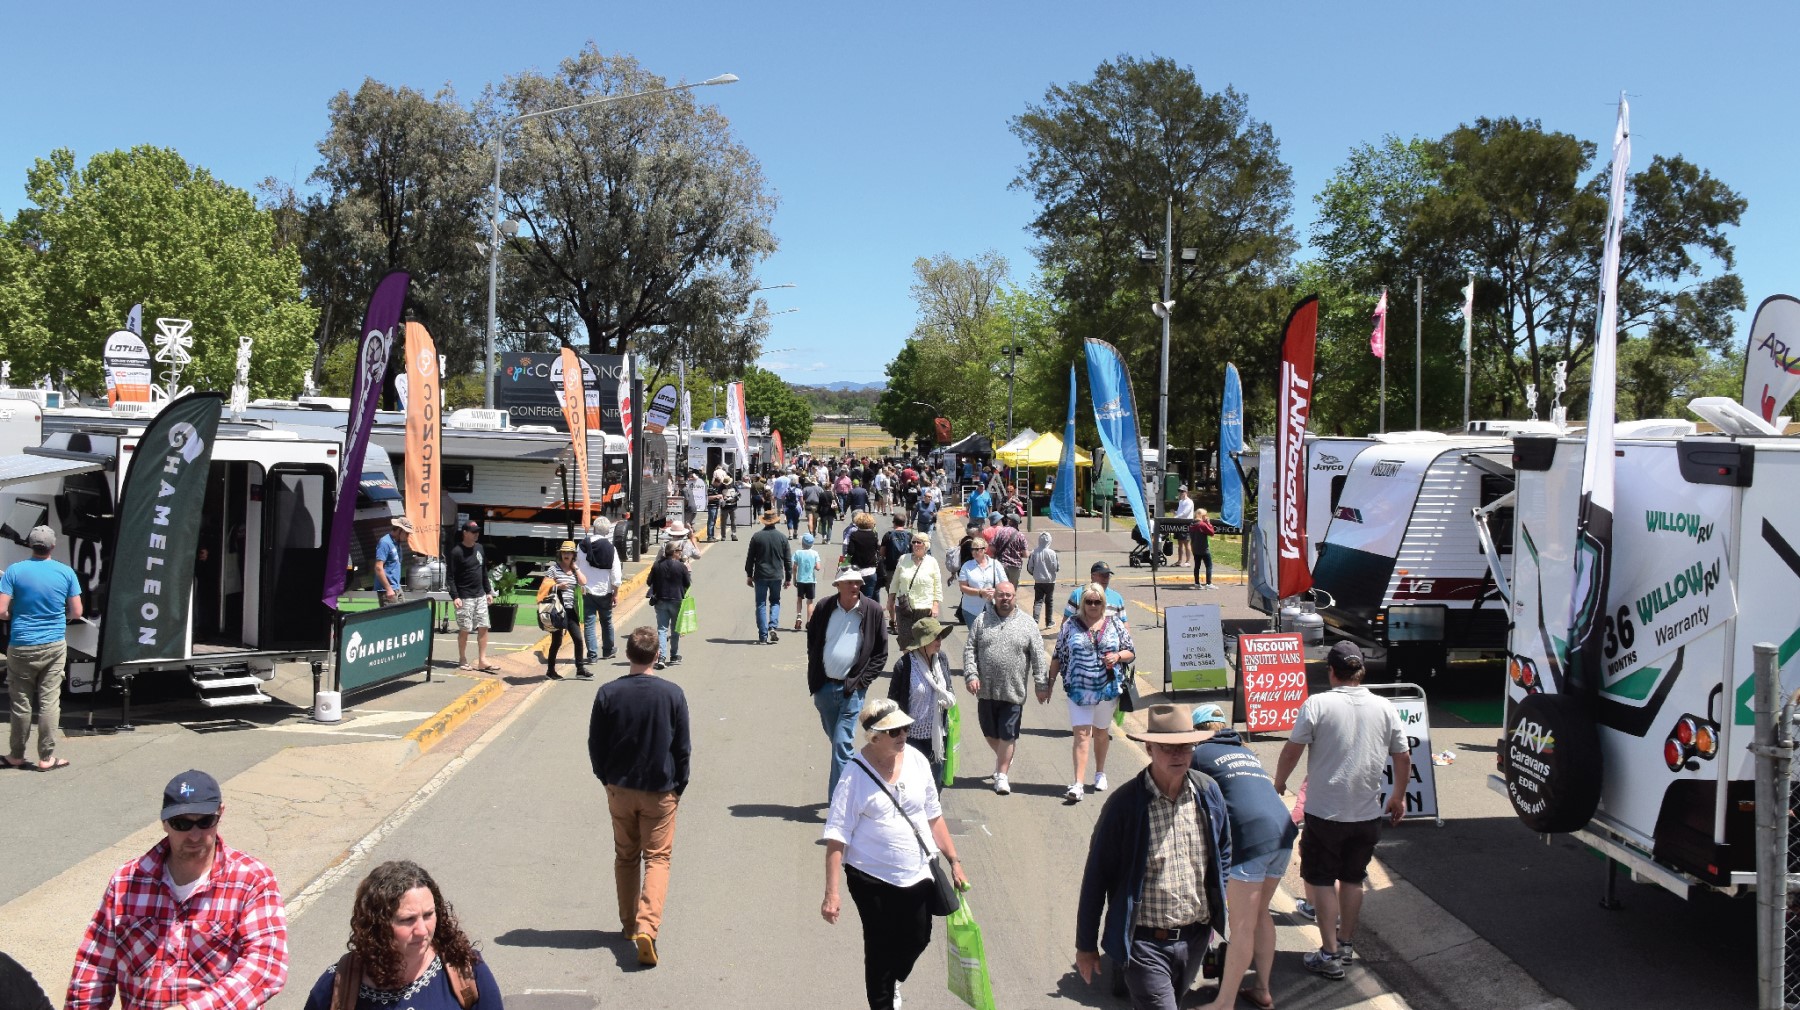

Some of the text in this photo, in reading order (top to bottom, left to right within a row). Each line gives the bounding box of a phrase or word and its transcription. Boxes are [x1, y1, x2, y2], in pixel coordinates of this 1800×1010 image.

[109, 344, 144, 353] LOTUS
[507, 365, 534, 381] epic
[510, 405, 563, 416] CONFERE
[1281, 361, 1309, 560] VISCOUNT
[1313, 463, 1344, 471] Jayco
[1646, 510, 1714, 544] WILLOW RV
[1635, 557, 1720, 625] WILLOW RV
[1604, 605, 1635, 660] 36
[1655, 605, 1709, 646] Warranty
[1244, 653, 1300, 665] ENSUITE VANS
[1607, 651, 1637, 677] MONTHS
[1245, 672, 1305, 691] $49,990
[1248, 690, 1302, 702] FAMILY VAN
[1249, 708, 1299, 728] $59,49
[1511, 717, 1553, 754] ARV
[1510, 745, 1551, 778] Caravans
[1509, 781, 1518, 797] 02
[1518, 776, 1539, 793] EDEN
